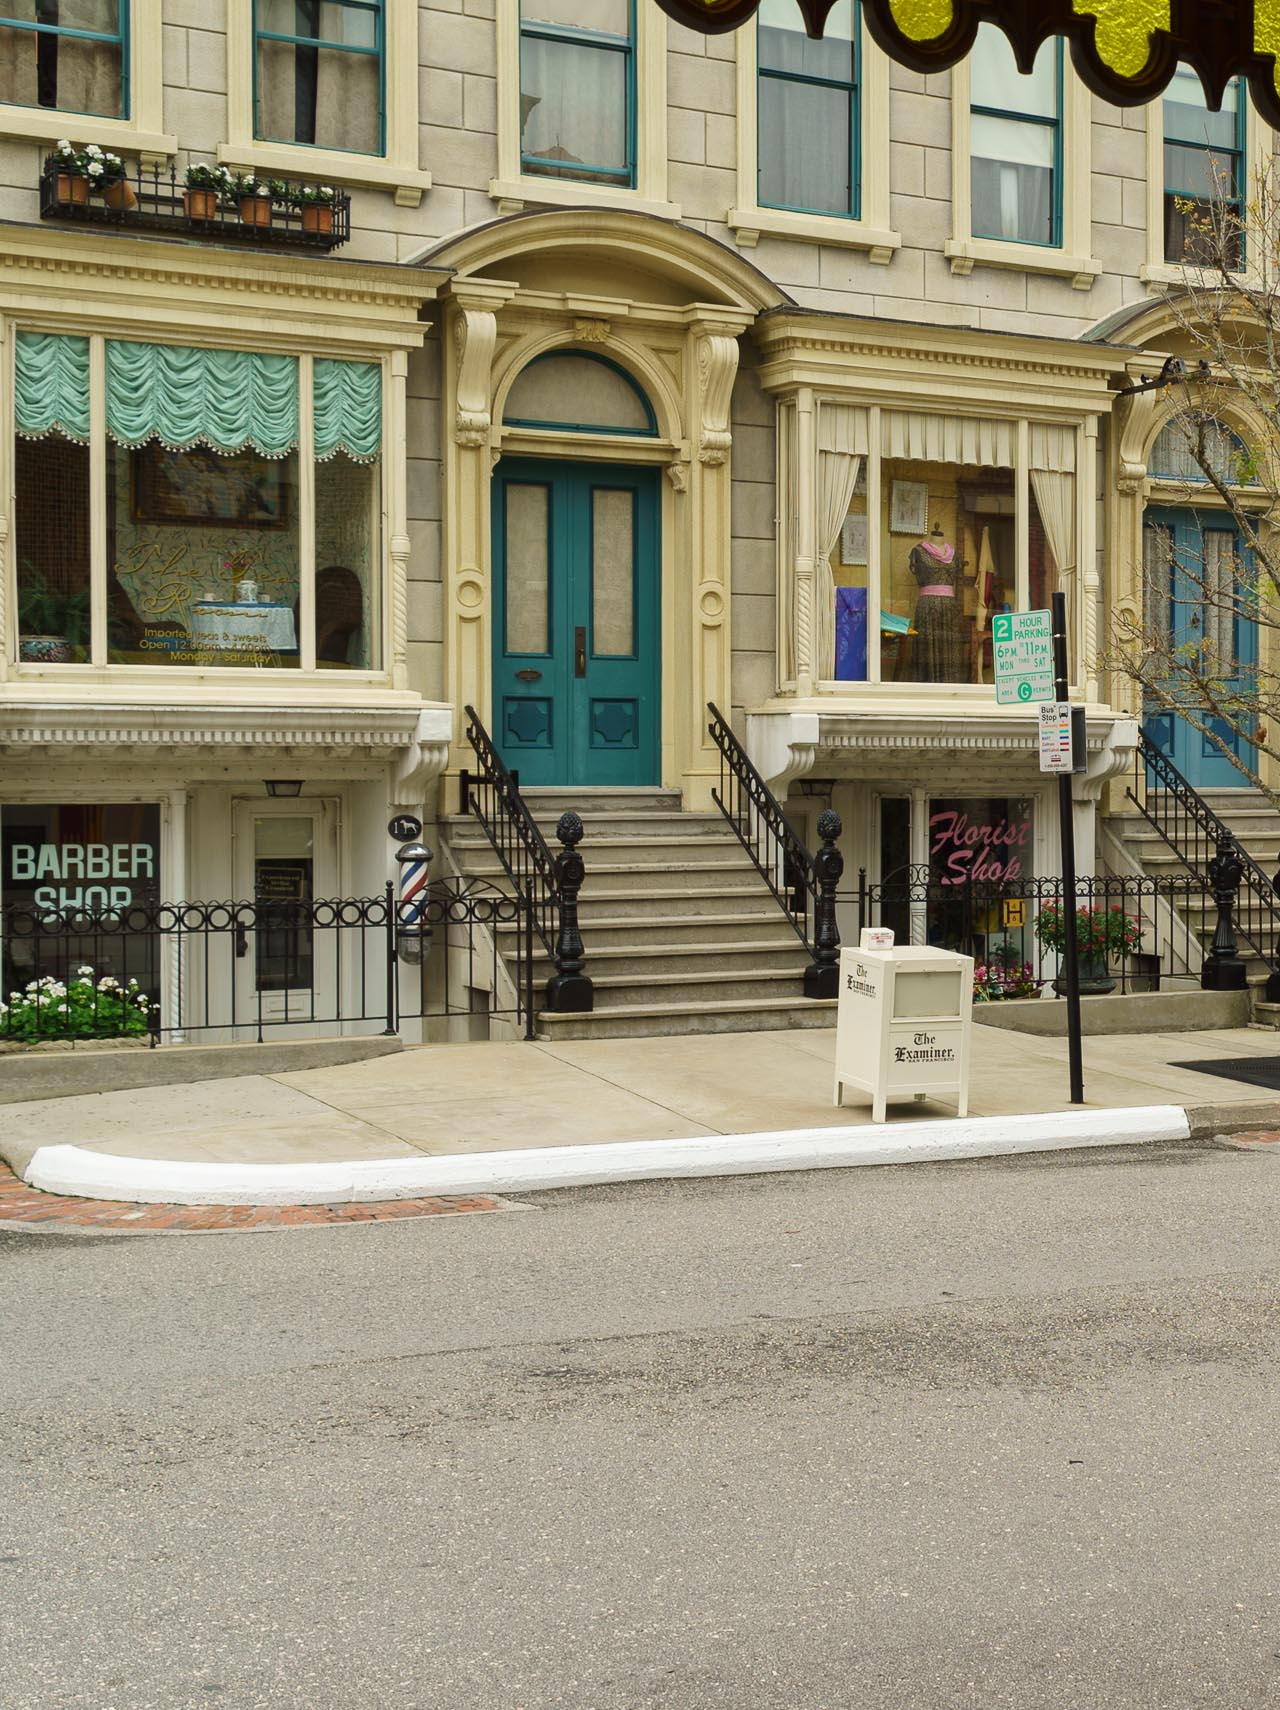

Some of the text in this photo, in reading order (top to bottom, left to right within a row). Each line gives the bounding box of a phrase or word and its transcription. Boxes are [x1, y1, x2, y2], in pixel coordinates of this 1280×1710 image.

[113, 539, 203, 575] The
[997, 616, 1042, 638] 2 HOUR
[1014, 627, 1049, 640] PARKING
[144, 627, 193, 640] Imported
[222, 632, 230, 642] &
[233, 632, 268, 643] sweets
[139, 639, 171, 650] Open
[170, 650, 215, 662] Monday
[224, 651, 271, 664] Saturday
[999, 660, 1014, 671] MON
[1034, 656, 1046, 668] SAT
[1020, 684, 1030, 699] G
[1041, 706, 1054, 714] Bus
[1041, 714, 1057, 722] Stop
[929, 811, 1032, 854] Florist
[11, 843, 154, 881] BARBER
[941, 846, 1022, 891] Shop
[34, 885, 132, 924] SHOP
[856, 963, 868, 978] The
[913, 1032, 936, 1046] The
